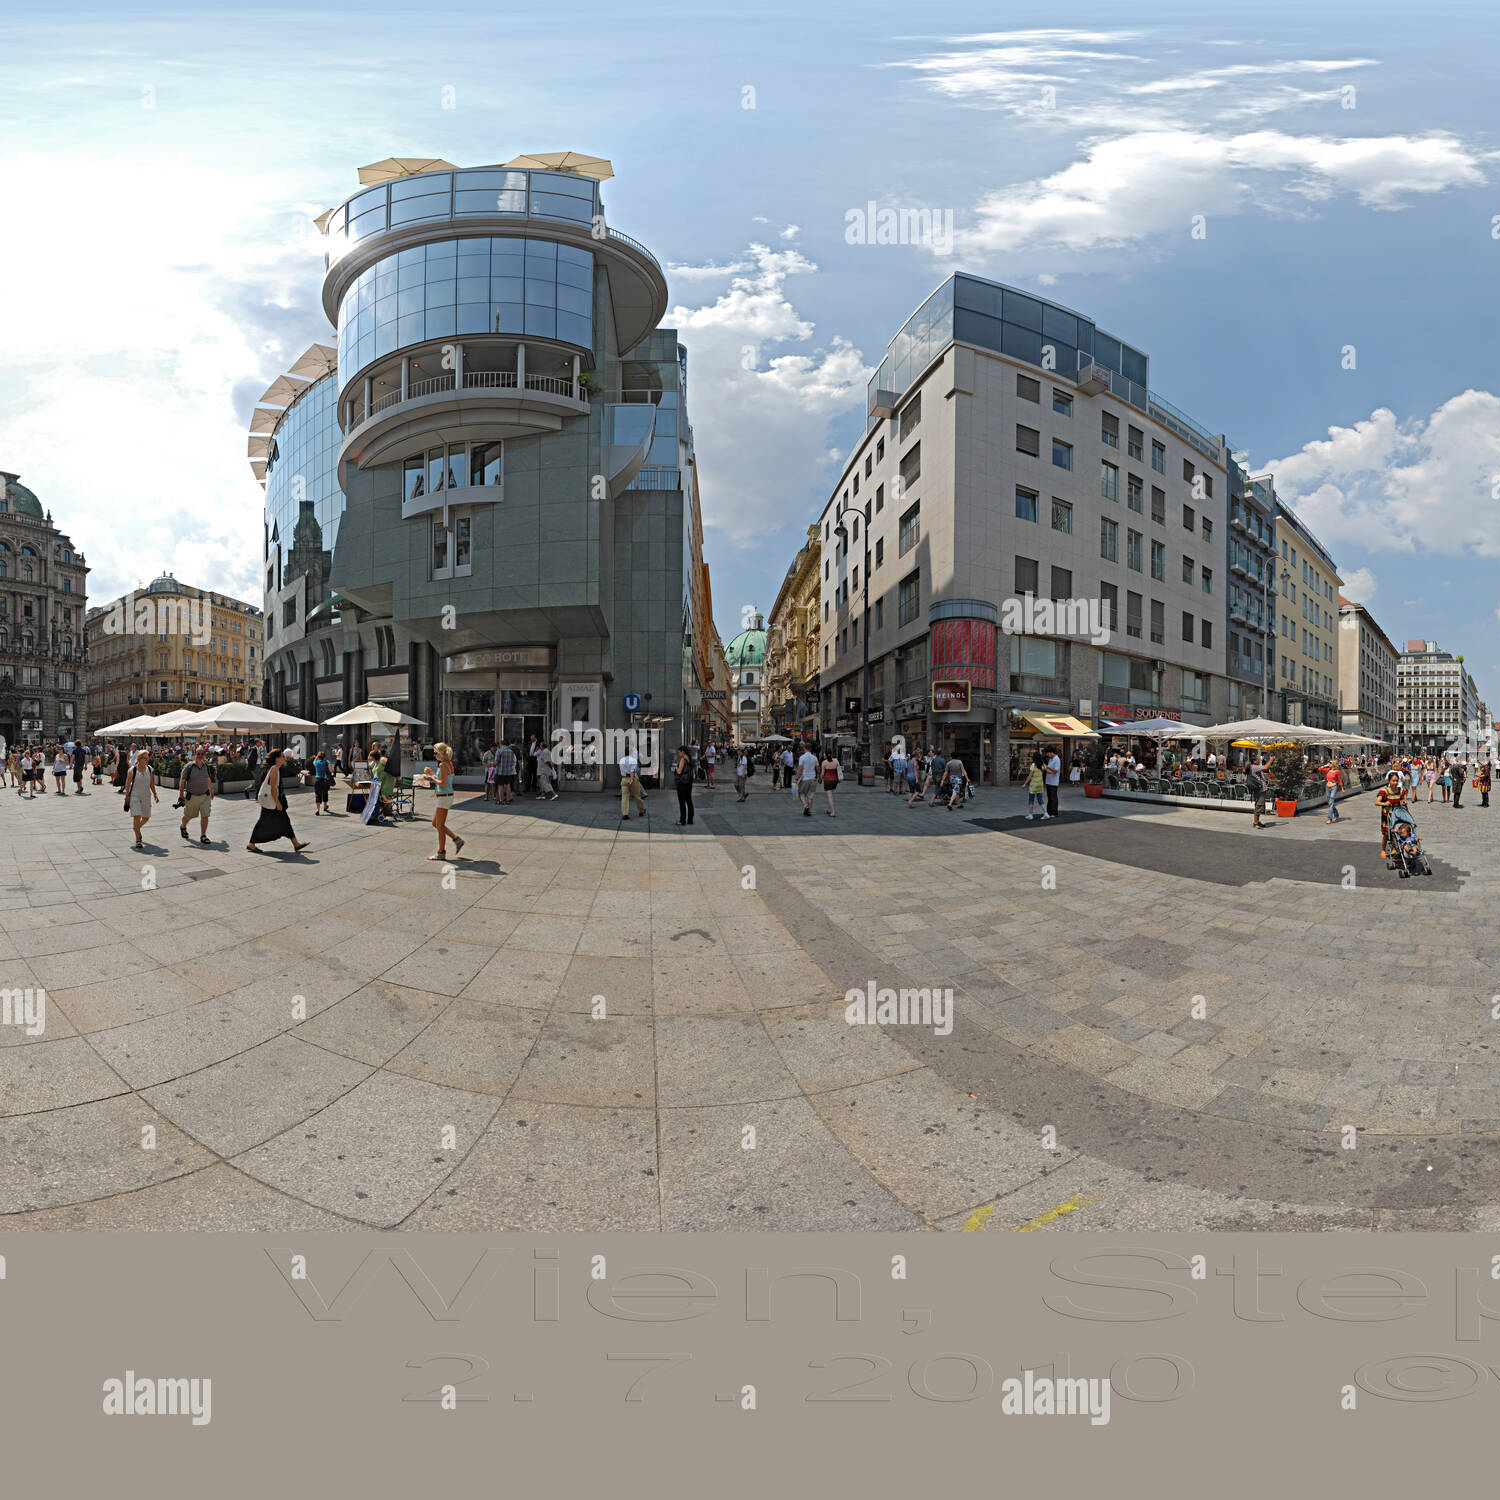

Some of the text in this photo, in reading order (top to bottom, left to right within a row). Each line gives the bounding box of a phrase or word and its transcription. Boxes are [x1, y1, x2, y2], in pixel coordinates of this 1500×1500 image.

[935, 691, 967, 699] HEINDL
[625, 697, 638, 710] U
[1135, 707, 1183, 721] SOUVENIRS
